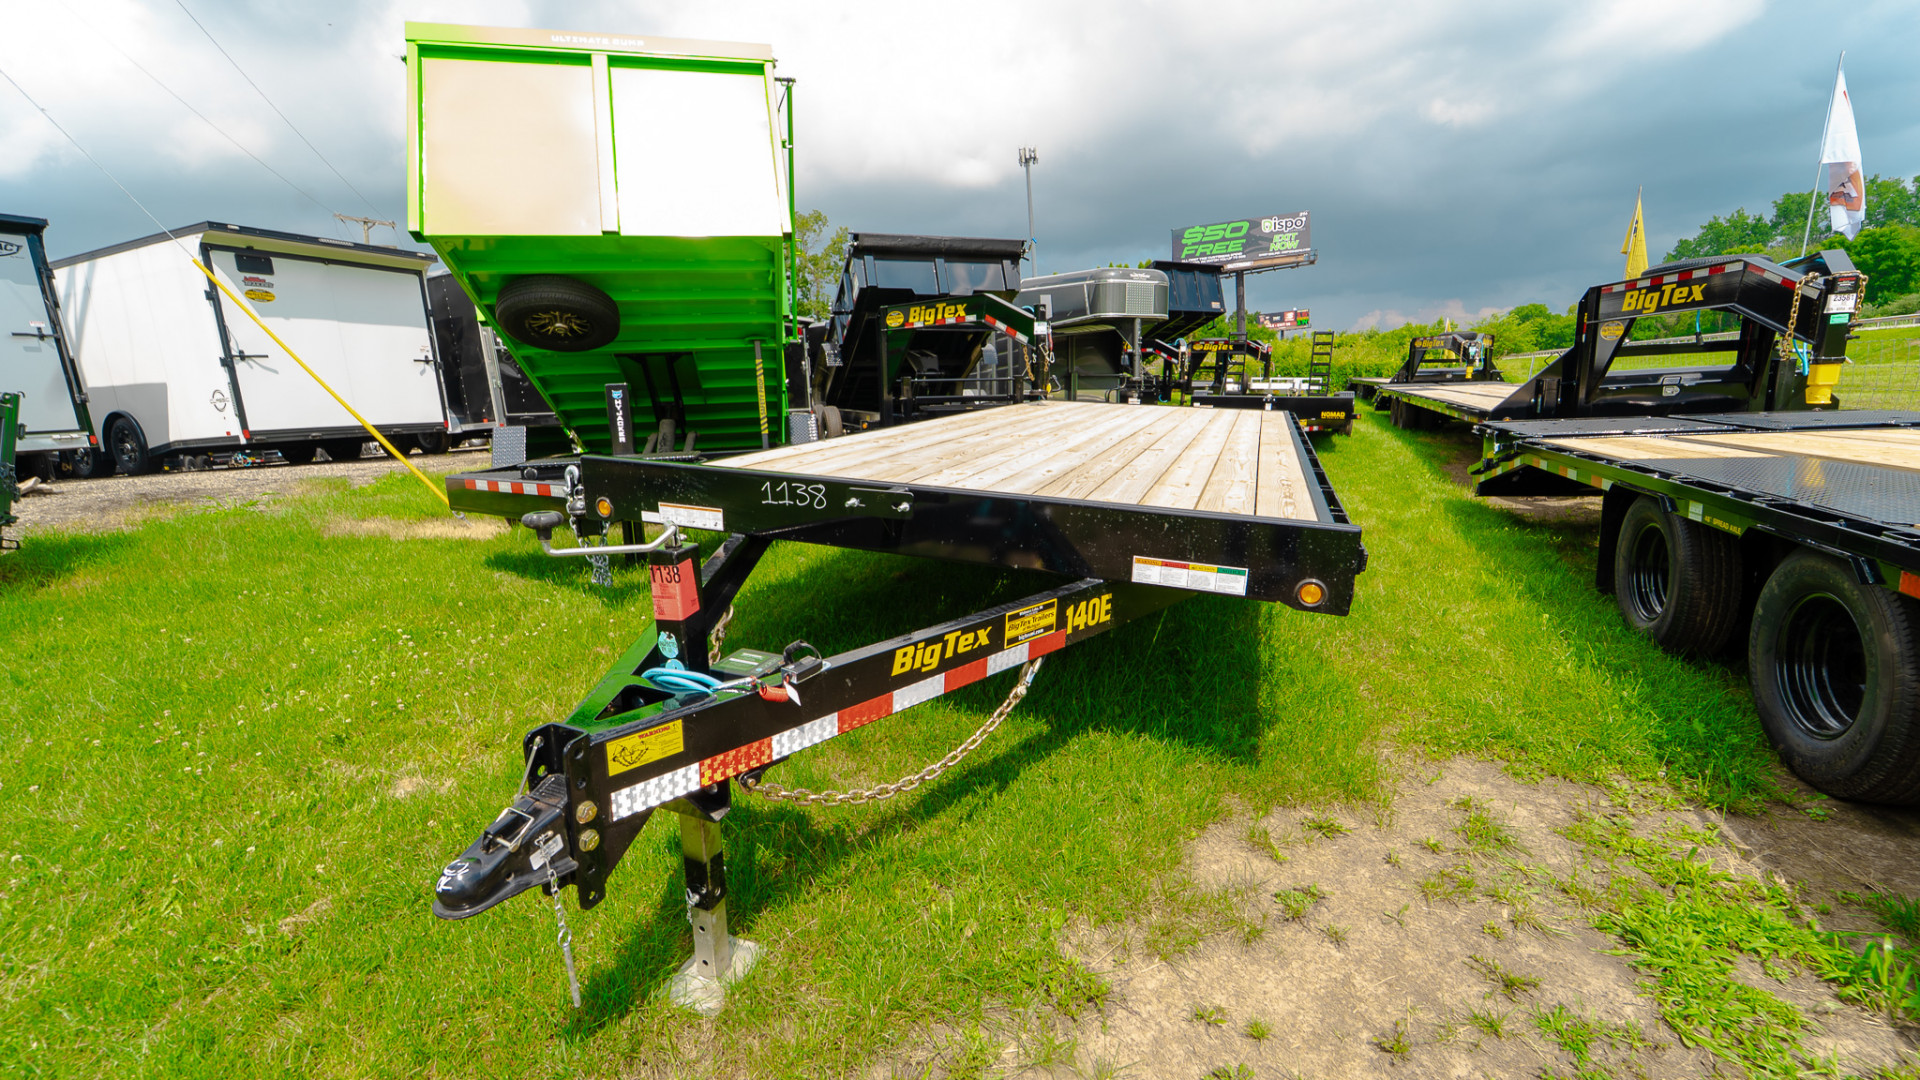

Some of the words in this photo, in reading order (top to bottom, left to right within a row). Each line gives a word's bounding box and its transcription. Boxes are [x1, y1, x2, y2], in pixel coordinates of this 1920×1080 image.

[1181, 220, 1250, 246] $50
[1181, 239, 1246, 258] FREE
[1270, 240, 1299, 251] NOW
[1622, 283, 1707, 314] BigTex
[909, 303, 967, 325] BigTex
[761, 481, 827, 510] 1138
[650, 565, 681, 584] 1138
[1032, 612, 1054, 623] Trailers
[1066, 593, 1112, 635] 140E
[891, 625, 993, 677] BigTex
[638, 726, 671, 739] WARNING
